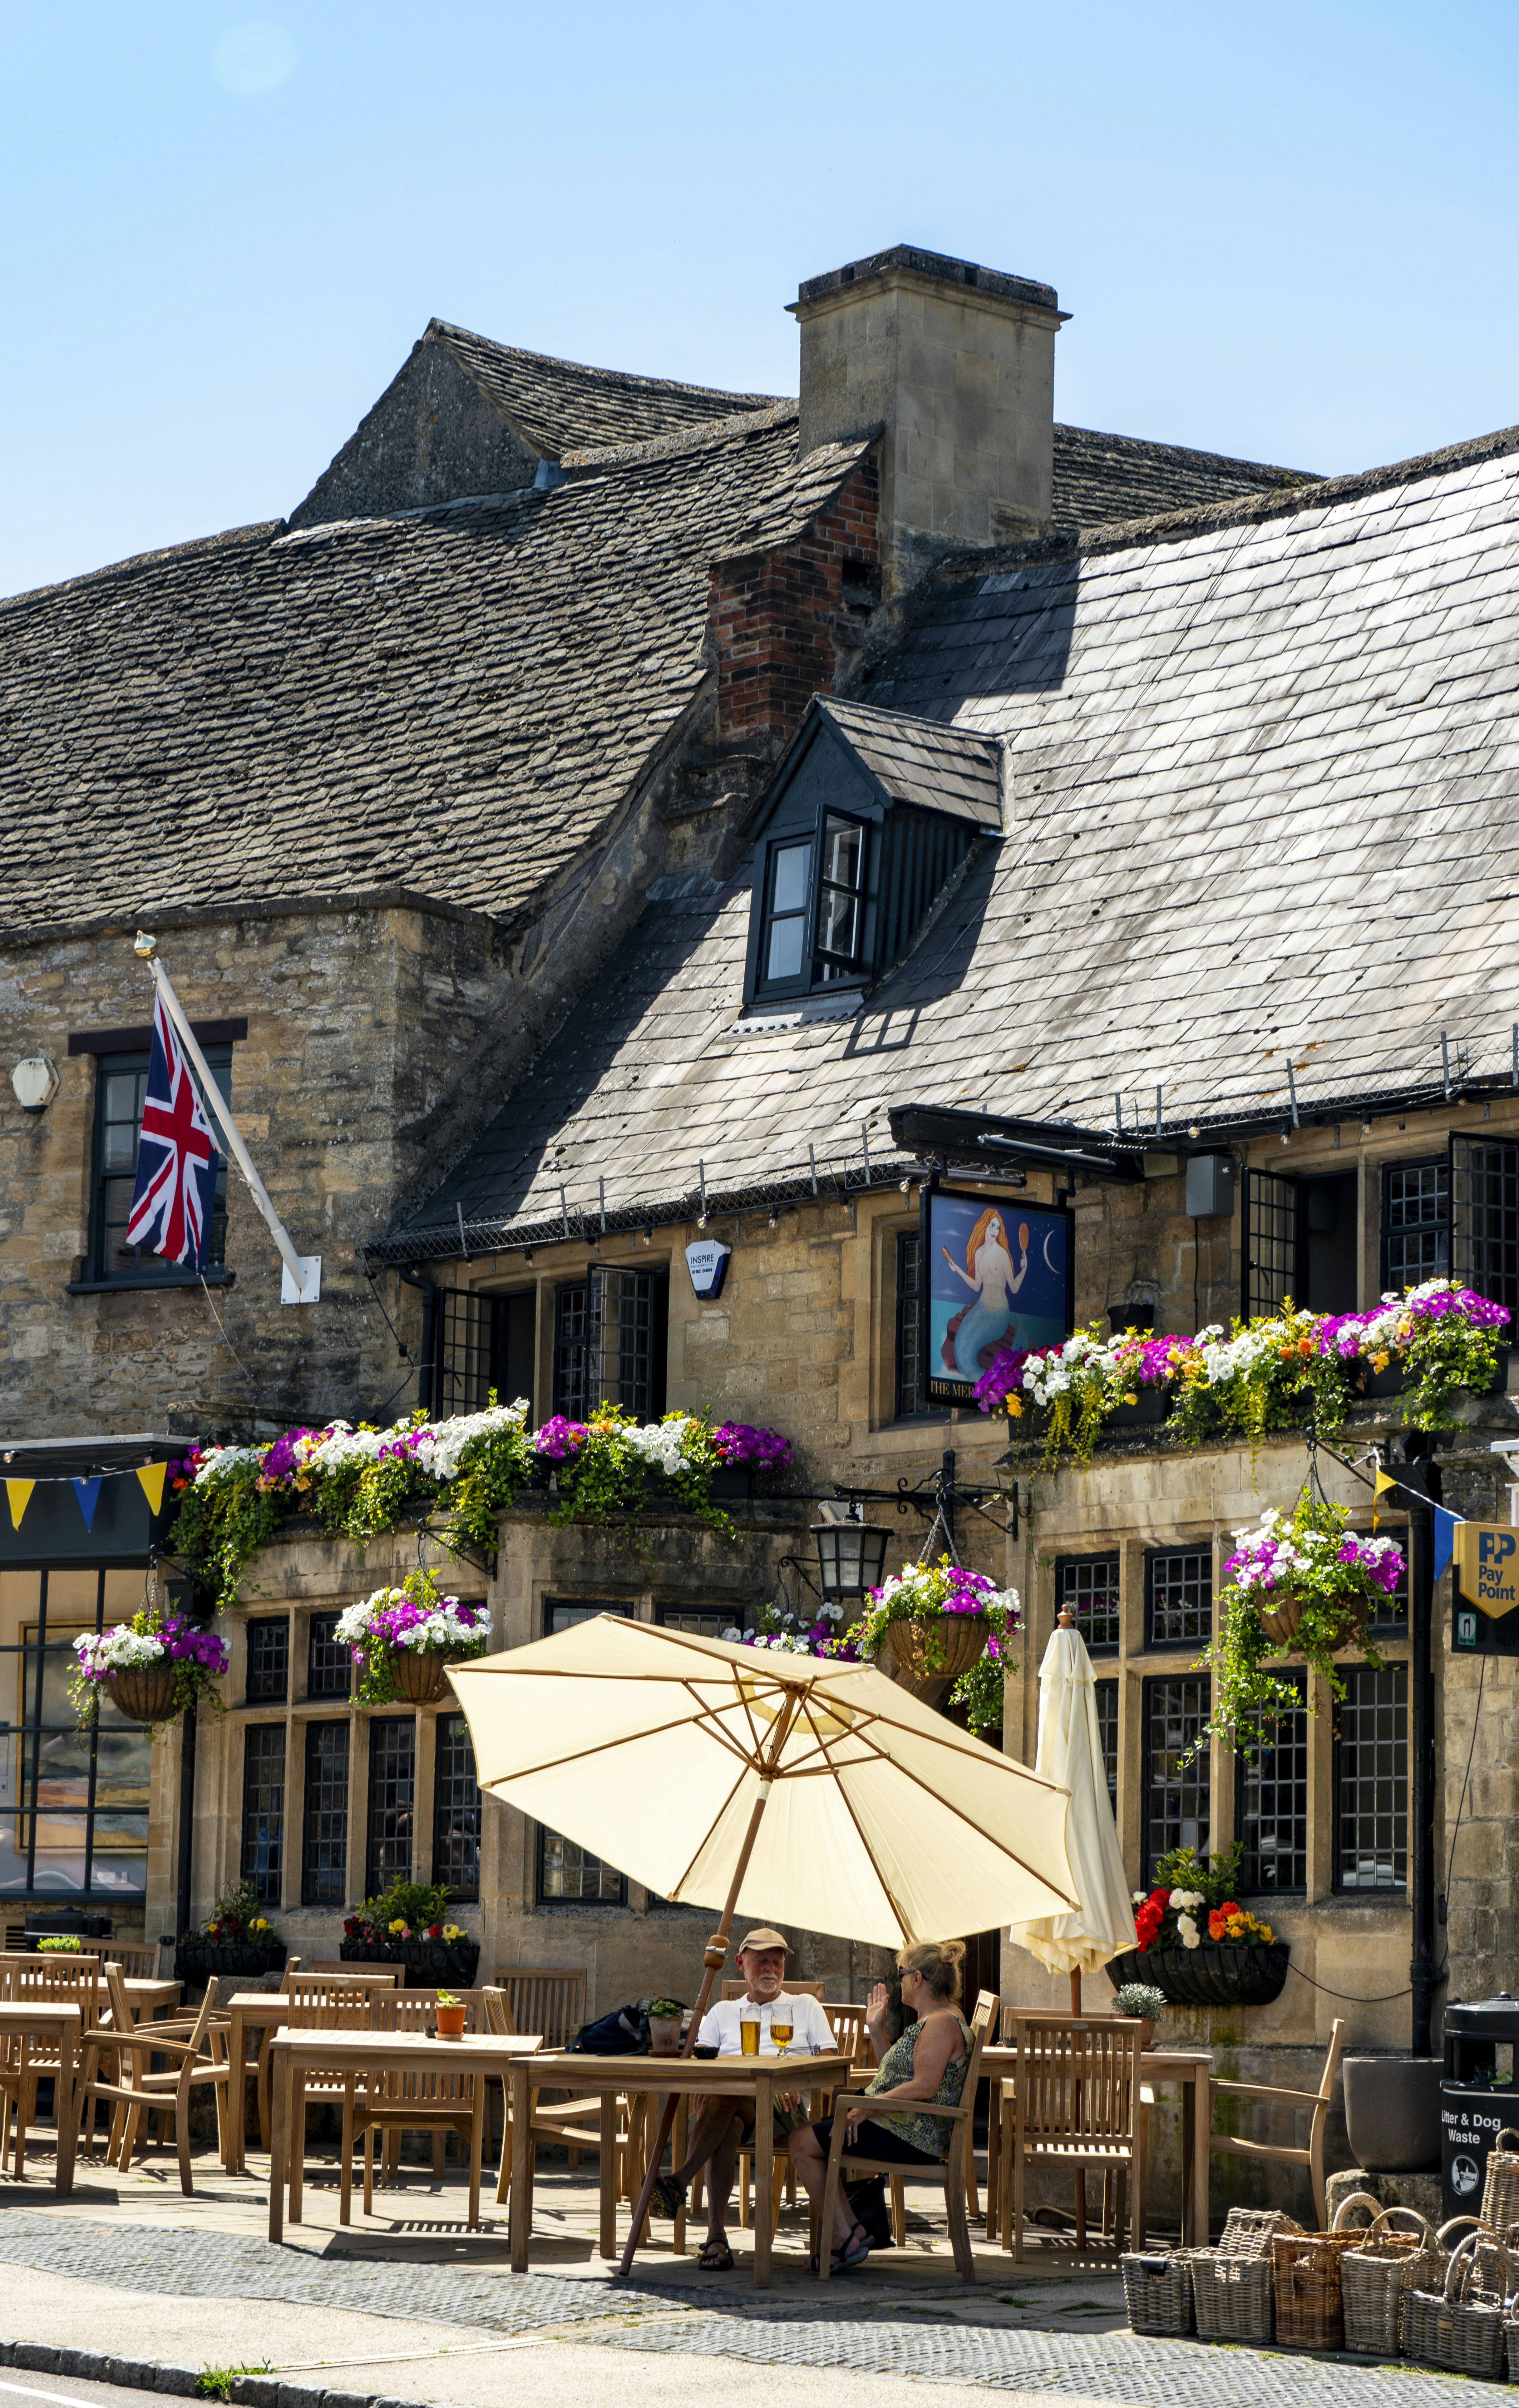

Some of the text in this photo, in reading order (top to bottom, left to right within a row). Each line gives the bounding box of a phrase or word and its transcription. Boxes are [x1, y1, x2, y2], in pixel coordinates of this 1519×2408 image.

[691, 1254, 714, 1264] INSPIRE
[931, 1381, 974, 1398] THE MER
[1479, 1531, 1516, 1564] PP
[1479, 1565, 1503, 1586] Pay
[1479, 1582, 1515, 1600] Point
[1442, 2110, 1501, 2131] Litter & Dog
[1448, 2128, 1480, 2144] Waste
